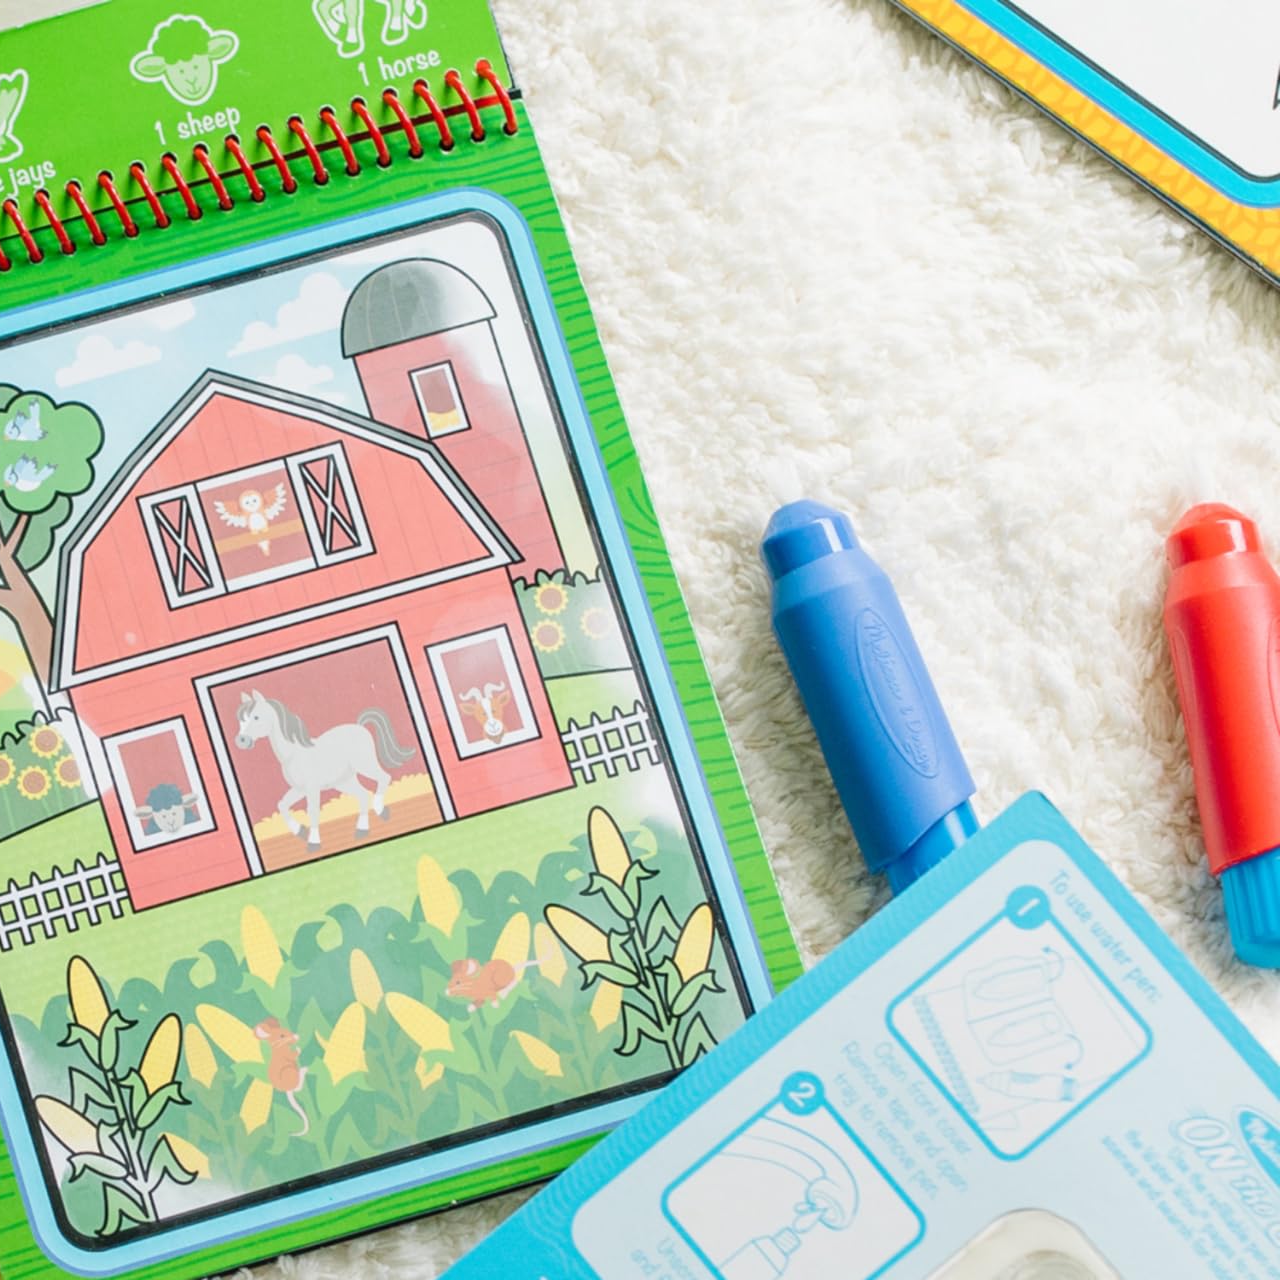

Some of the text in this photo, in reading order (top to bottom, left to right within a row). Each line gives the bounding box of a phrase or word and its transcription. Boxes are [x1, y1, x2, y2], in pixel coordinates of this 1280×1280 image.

[357, 49, 442, 87] 1 horse
[154, 106, 242, 146] 1 sheep
[7, 160, 56, 198] jays
[787, 1080, 817, 1108] 2
